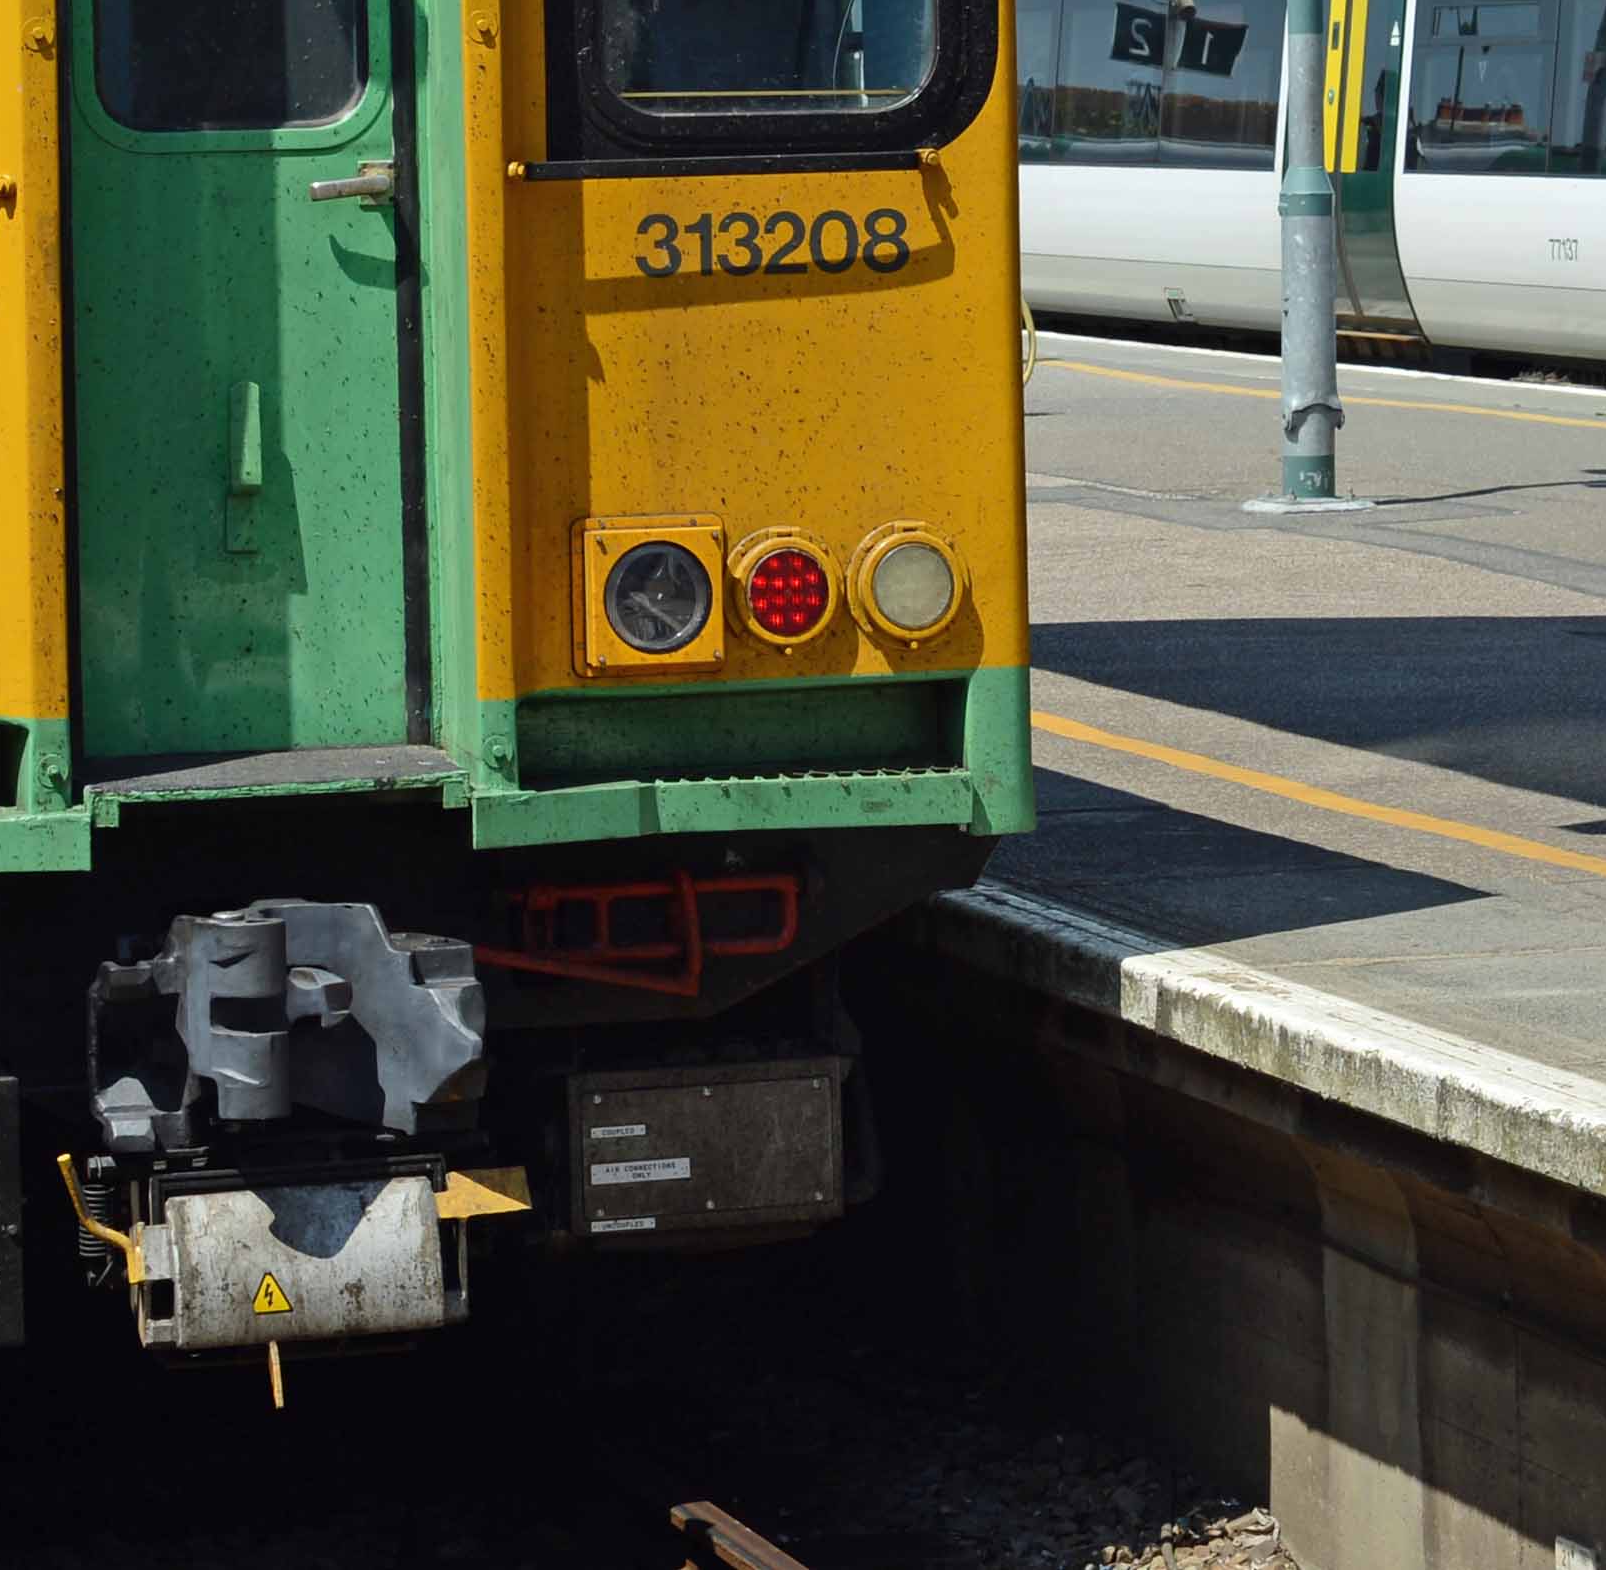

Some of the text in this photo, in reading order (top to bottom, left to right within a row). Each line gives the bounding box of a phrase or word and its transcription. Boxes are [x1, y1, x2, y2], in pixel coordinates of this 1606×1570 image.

[635, 208, 910, 278] 313208
[1548, 238, 1578, 261] 77137
[605, 1161, 676, 1174] AIR CONNECTIONS
[631, 1171, 651, 1180] ONLY
